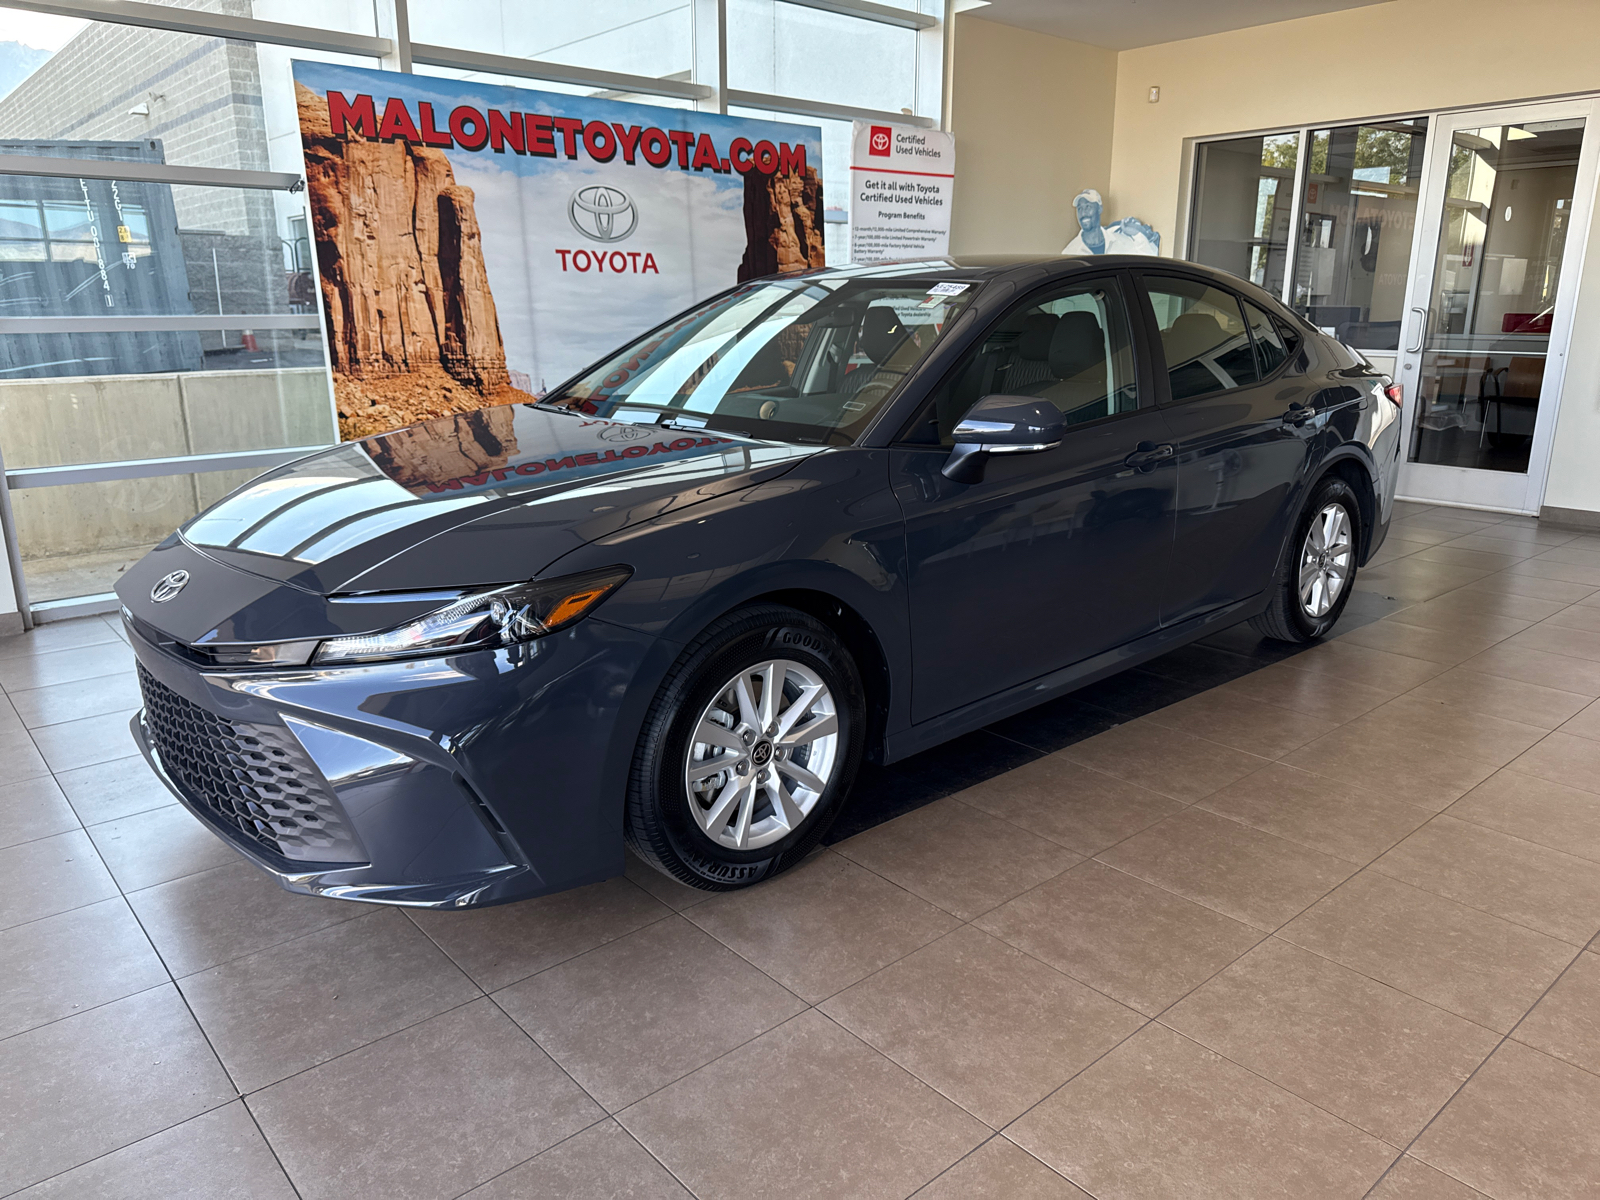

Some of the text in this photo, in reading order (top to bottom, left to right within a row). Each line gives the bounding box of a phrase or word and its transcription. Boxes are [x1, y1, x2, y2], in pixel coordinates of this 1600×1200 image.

[326, 90, 807, 178] MALONETOYOTA.COM
[896, 133, 926, 145] Certified
[895, 145, 941, 158] Used Vehicles
[865, 180, 940, 195] Get it all with Toyota
[860, 192, 943, 206] Certified Used Vehicles
[878, 211, 925, 220] Program Benefits
[554, 248, 660, 275] TOYOTA
